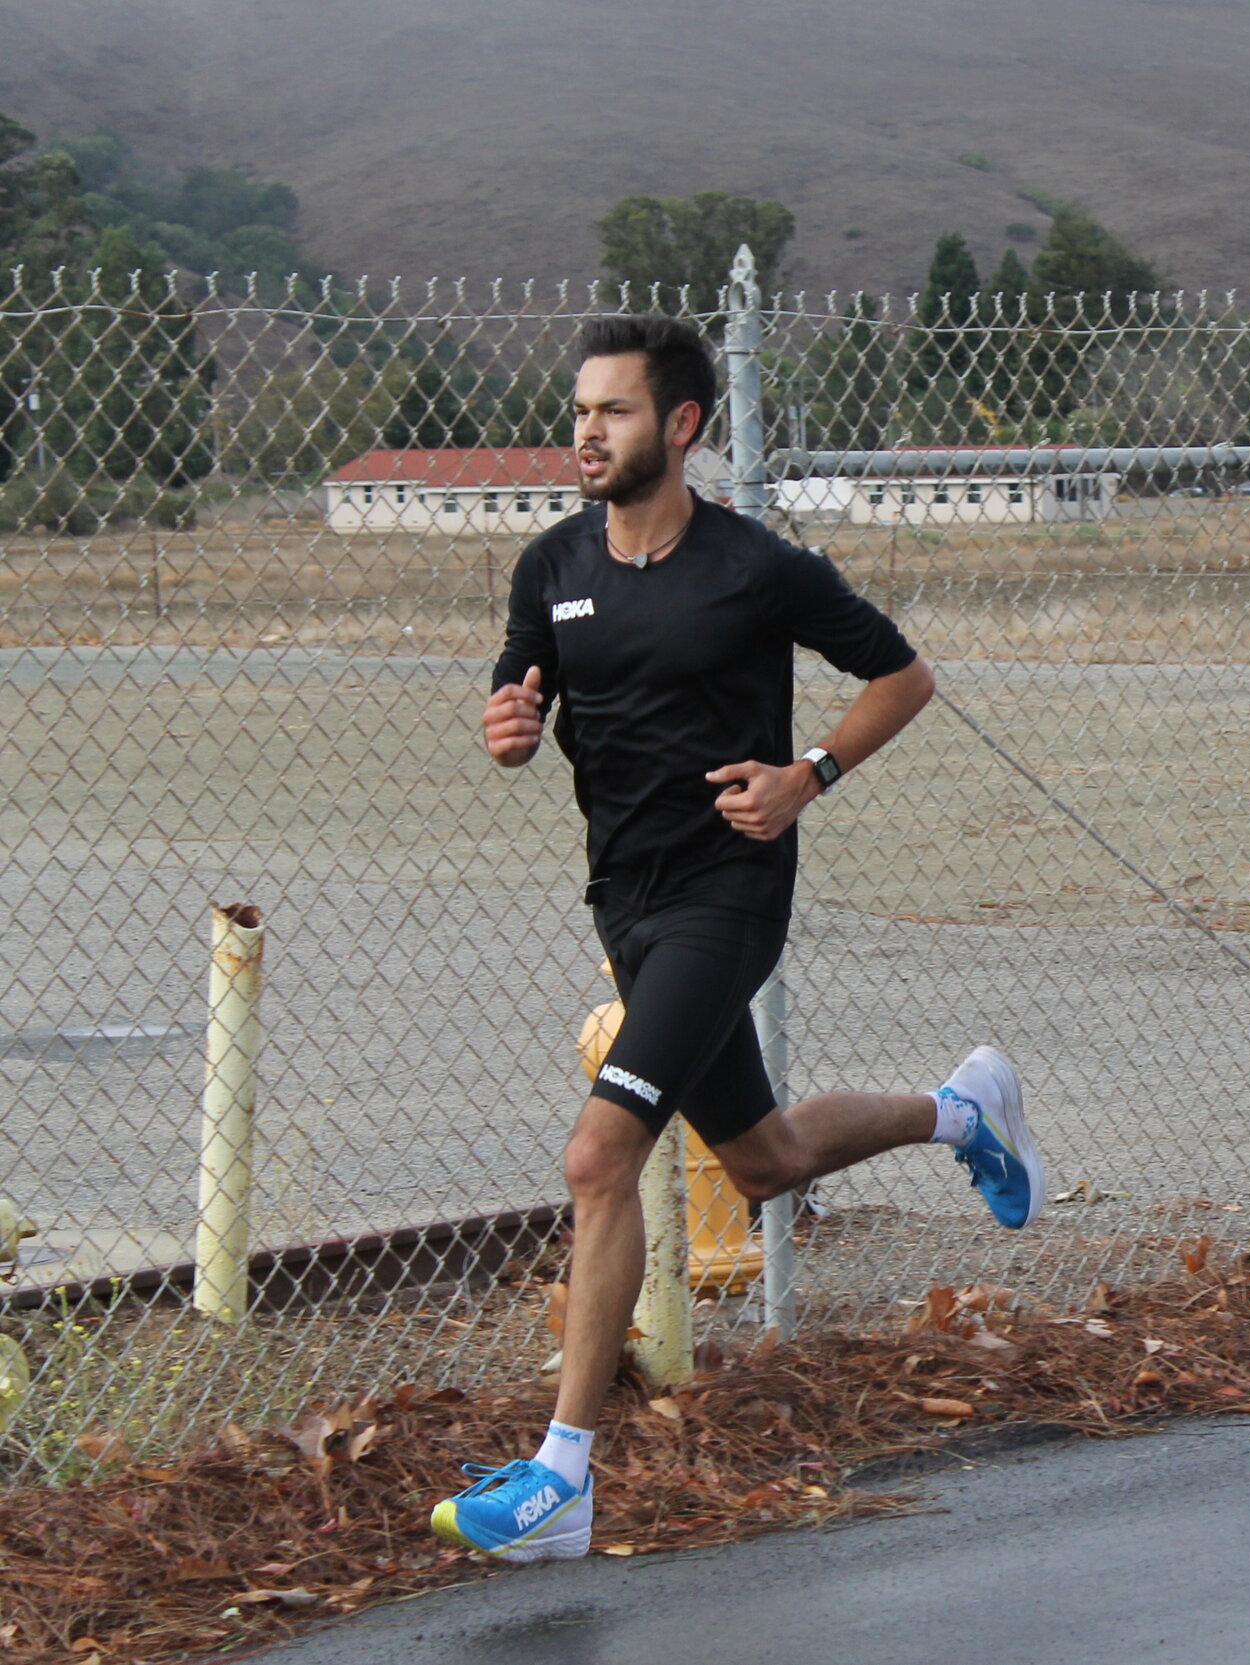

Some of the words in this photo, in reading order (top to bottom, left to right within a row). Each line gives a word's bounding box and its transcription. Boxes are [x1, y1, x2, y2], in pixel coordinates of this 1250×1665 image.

[552, 597, 595, 623] HOKA
[599, 1063, 645, 1096] HOKA
[513, 1485, 560, 1531] HOKA
